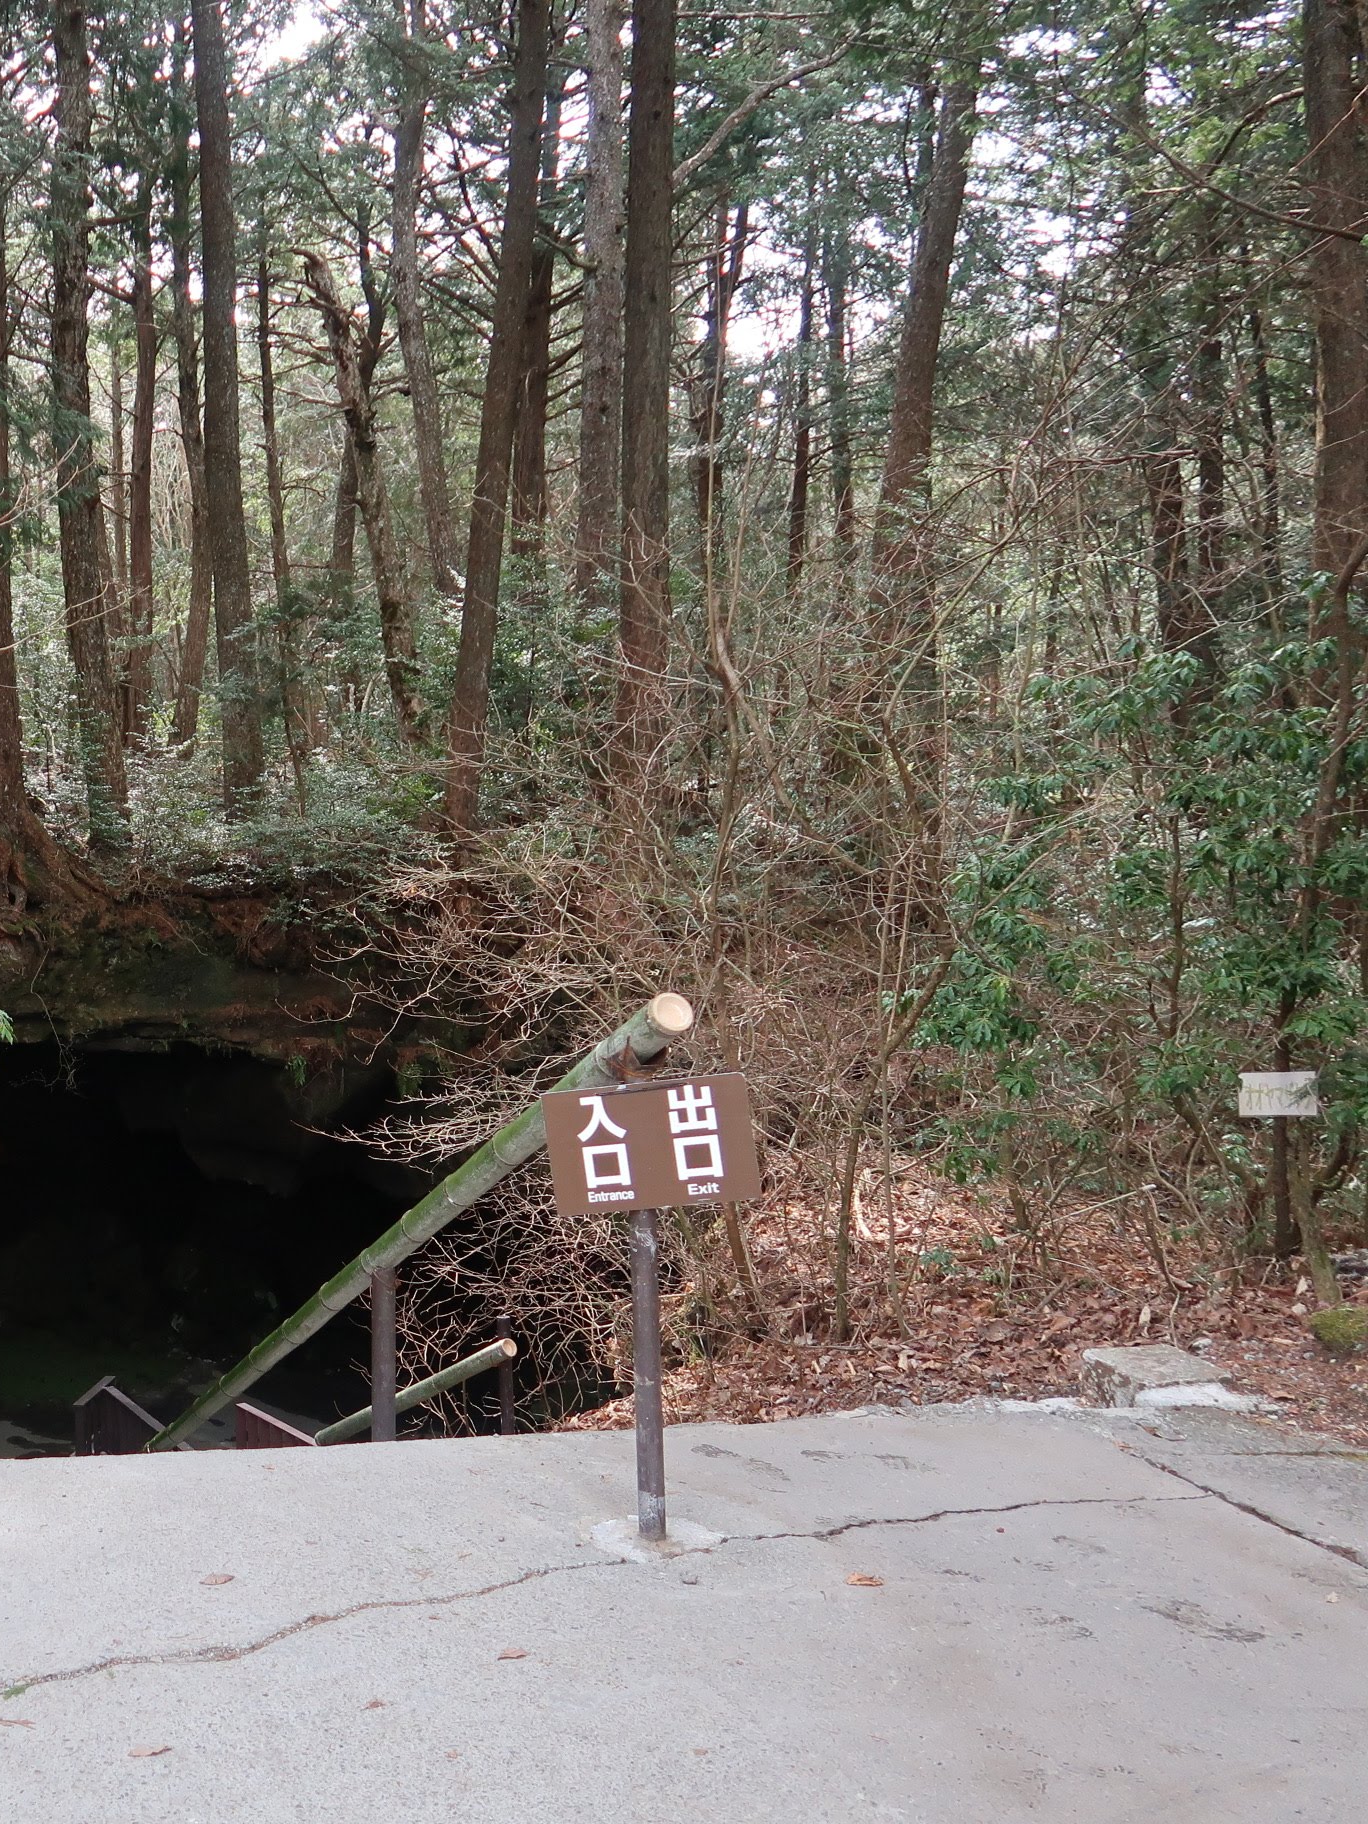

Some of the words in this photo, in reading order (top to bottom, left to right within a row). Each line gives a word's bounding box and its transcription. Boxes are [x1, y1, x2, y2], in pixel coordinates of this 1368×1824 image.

[577, 1095, 632, 1189] 入口
[667, 1084, 724, 1181] 出口
[587, 1189, 635, 1203] Entrance
[687, 1182, 720, 1196] Exit
